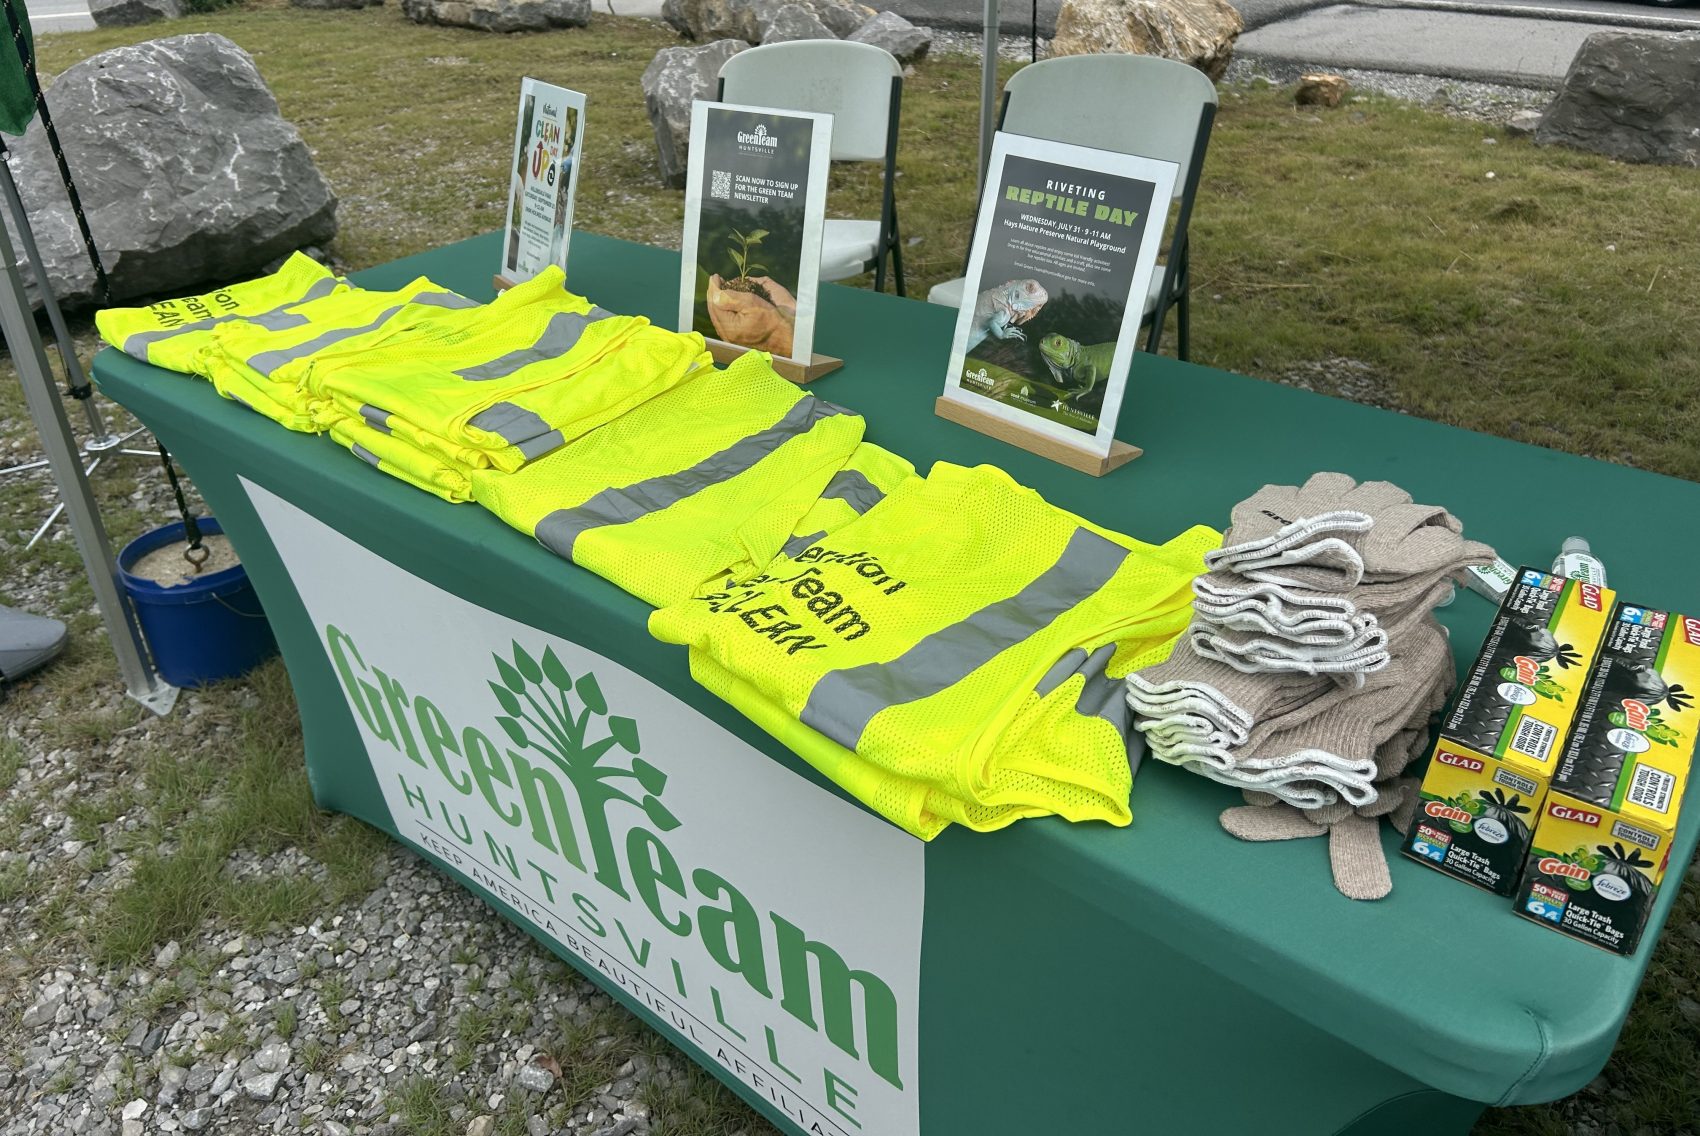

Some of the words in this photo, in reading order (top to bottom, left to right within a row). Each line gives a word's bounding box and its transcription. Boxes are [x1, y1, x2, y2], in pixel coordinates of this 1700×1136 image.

[535, 119, 561, 144] CLEAN
[737, 130, 778, 147] GreenTeam
[738, 144, 774, 154] HUNTSVILLE
[532, 141, 550, 182] UP
[734, 183, 746, 191] FOR
[747, 185, 757, 193] THE
[758, 187, 776, 196] GREEN
[777, 190, 793, 199] TEAM
[735, 174, 751, 183] SCAN
[751, 176, 765, 185] NOW
[766, 179, 774, 187] TO
[774, 180, 789, 189] SIGN
[789, 182, 798, 191] UP
[1045, 179, 1106, 200] RIVETING
[733, 191, 768, 204] NEWSLETTER
[1005, 185, 1089, 216] REPTILE
[1093, 204, 1139, 227] DAY
[1019, 213, 1058, 228] WEDNESDAY,
[1057, 221, 1073, 232] JULY
[1073, 225, 1080, 233] 31
[1099, 231, 1111, 240] AM
[1003, 218, 1018, 229] Hays
[1018, 222, 1039, 233] Nature
[1039, 227, 1065, 239] Preserve
[1065, 233, 1089, 245] Natural
[1088, 238, 1126, 255] Playground
[965, 368, 995, 386] GreenTeam
[1522, 570, 1541, 582] 6
[1581, 583, 1600, 610] GLAD
[1623, 606, 1642, 617] 6
[1514, 656, 1540, 686] Gain
[1621, 698, 1648, 732] Gain
[1521, 721, 1534, 738] TOUGH
[1526, 722, 1545, 755] CONTROLS
[1515, 736, 1528, 751] ODOR
[1438, 752, 1482, 771] GLAD
[1499, 773, 1533, 792] CONTROLS
[1637, 767, 1650, 787] TOUGH
[1631, 785, 1644, 803] ODOR
[1646, 771, 1662, 808] CONTROLS
[1425, 801, 1472, 824] Gain
[1551, 806, 1599, 825] GLAD
[1478, 822, 1504, 839] febreze
[1616, 832, 1636, 842] TOUGH
[1618, 828, 1656, 845] CONTROLS
[326, 624, 904, 1091] GreenTeam
[1413, 843, 1428, 856] 6
[1450, 844, 1471, 857] Large
[1470, 852, 1490, 866] Trash
[1445, 857, 1453, 866] 30
[1453, 861, 1474, 876] Gallon
[1473, 868, 1496, 884] Capacity
[1484, 865, 1500, 880] Bags
[1538, 858, 1590, 881] Gain
[1596, 879, 1628, 896] febreze
[1527, 901, 1544, 914] 6
[1568, 902, 1590, 916] Large
[1591, 911, 1612, 925] Trash
[1562, 917, 1572, 925] 30
[1572, 919, 1593, 934] Gallon
[1593, 928, 1619, 944] Capacity
[1605, 923, 1624, 939] Bags
[397, 772, 862, 1130] HUNTSVILLE
[420, 832, 463, 866] KEEP
[472, 867, 558, 936] AMERICA
[566, 933, 704, 1045] BEAUTIFUL
[717, 1047, 837, 1136] AFFILIA
